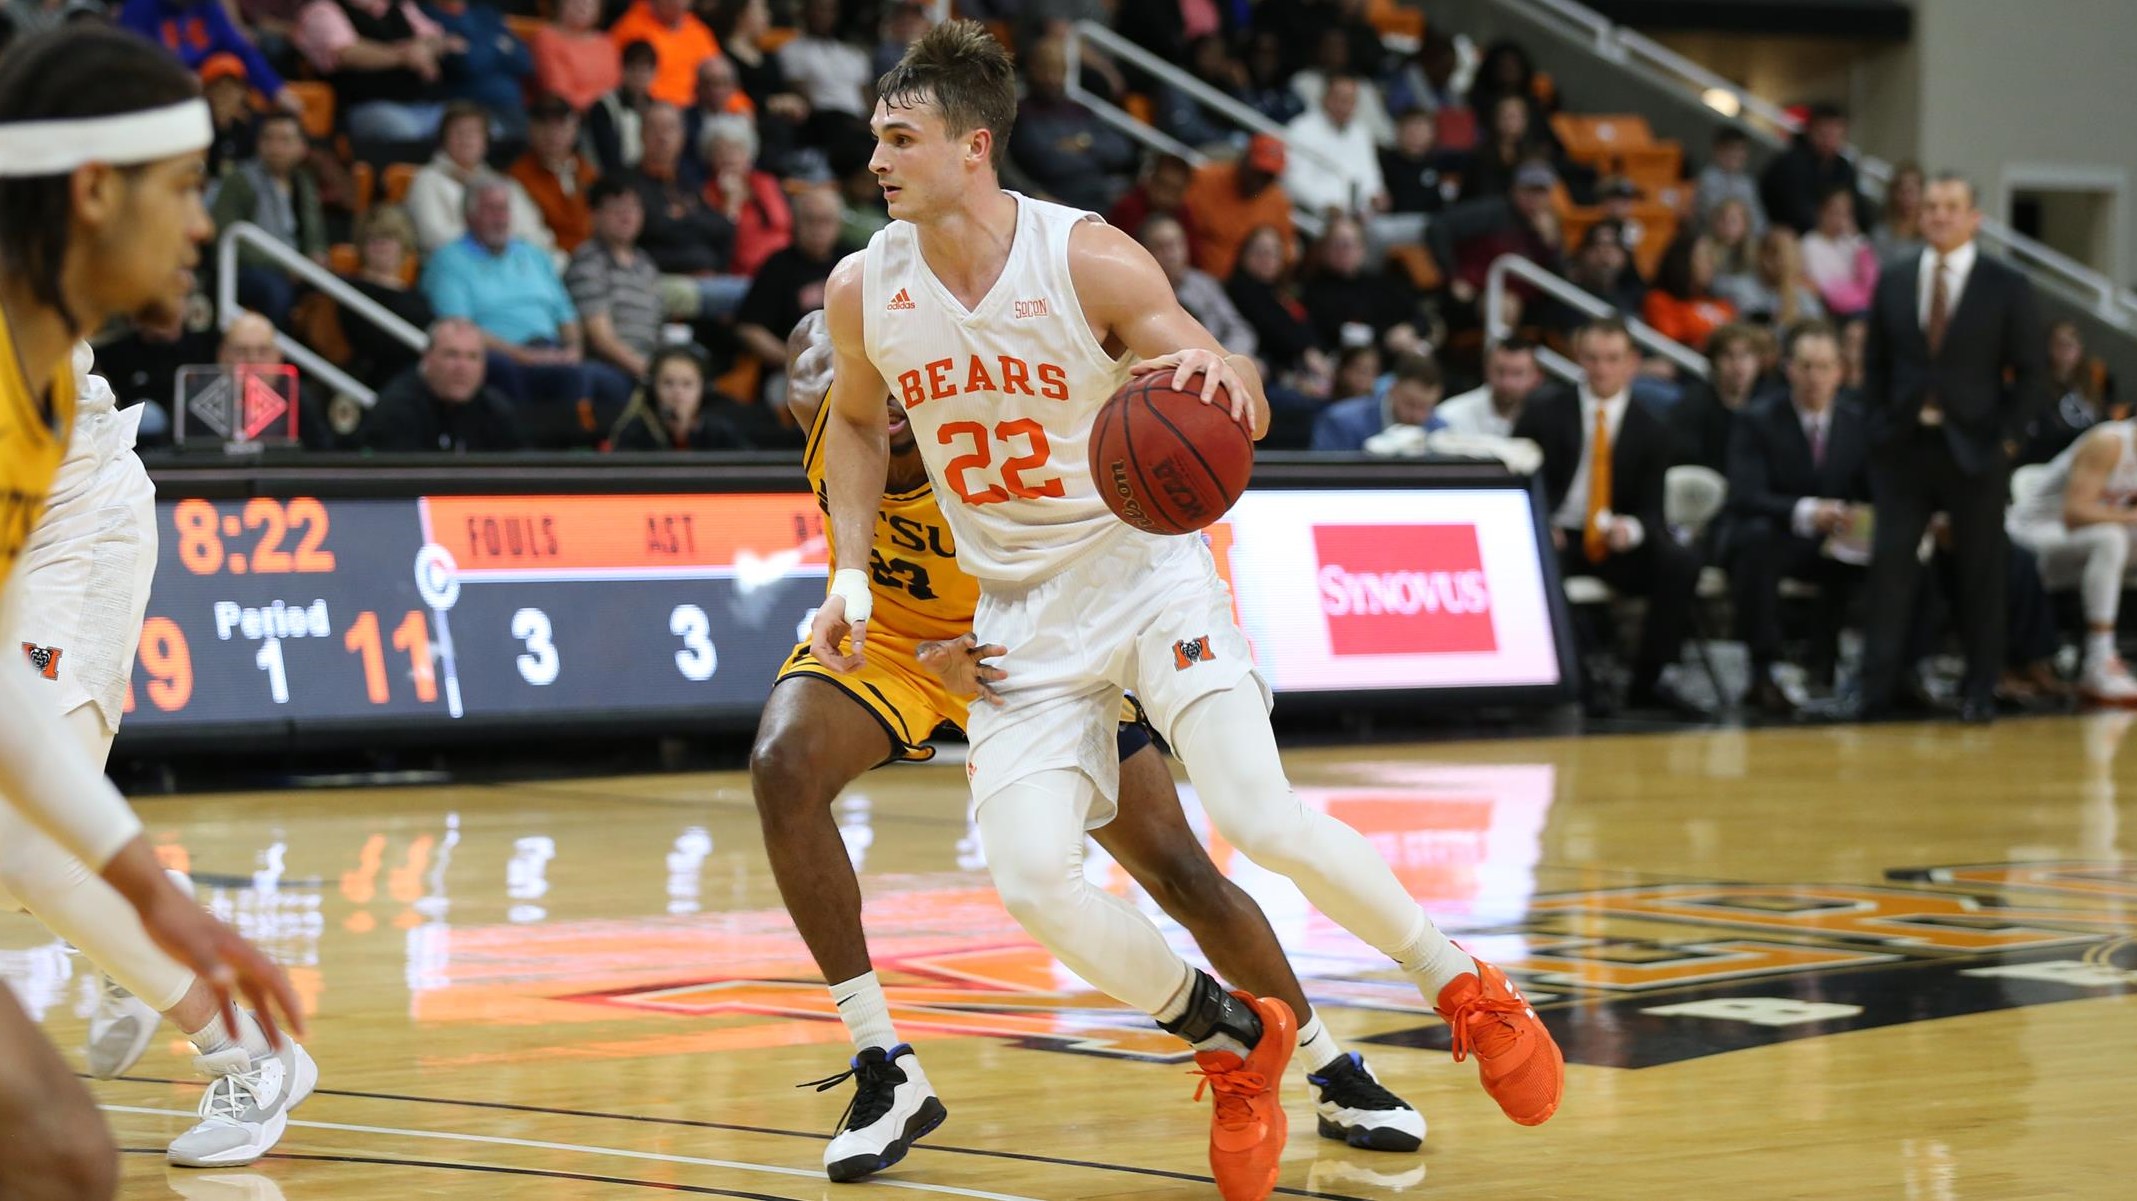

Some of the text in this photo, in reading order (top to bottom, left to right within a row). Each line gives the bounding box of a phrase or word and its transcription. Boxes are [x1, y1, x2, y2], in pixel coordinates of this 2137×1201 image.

[886, 300, 916, 311] adidas
[898, 354, 1069, 410] BEARS
[937, 417, 1066, 506] 22
[173, 496, 336, 575] 8:22
[467, 514, 558, 557] FOULS
[646, 512, 696, 553] AST
[214, 598, 331, 640] Period
[1319, 563, 1490, 617] SYNOVUS
[121, 616, 194, 712] 9
[255, 637, 289, 704] 1
[344, 610, 438, 703] 11
[511, 607, 560, 686] 3
[669, 603, 718, 681] 3
